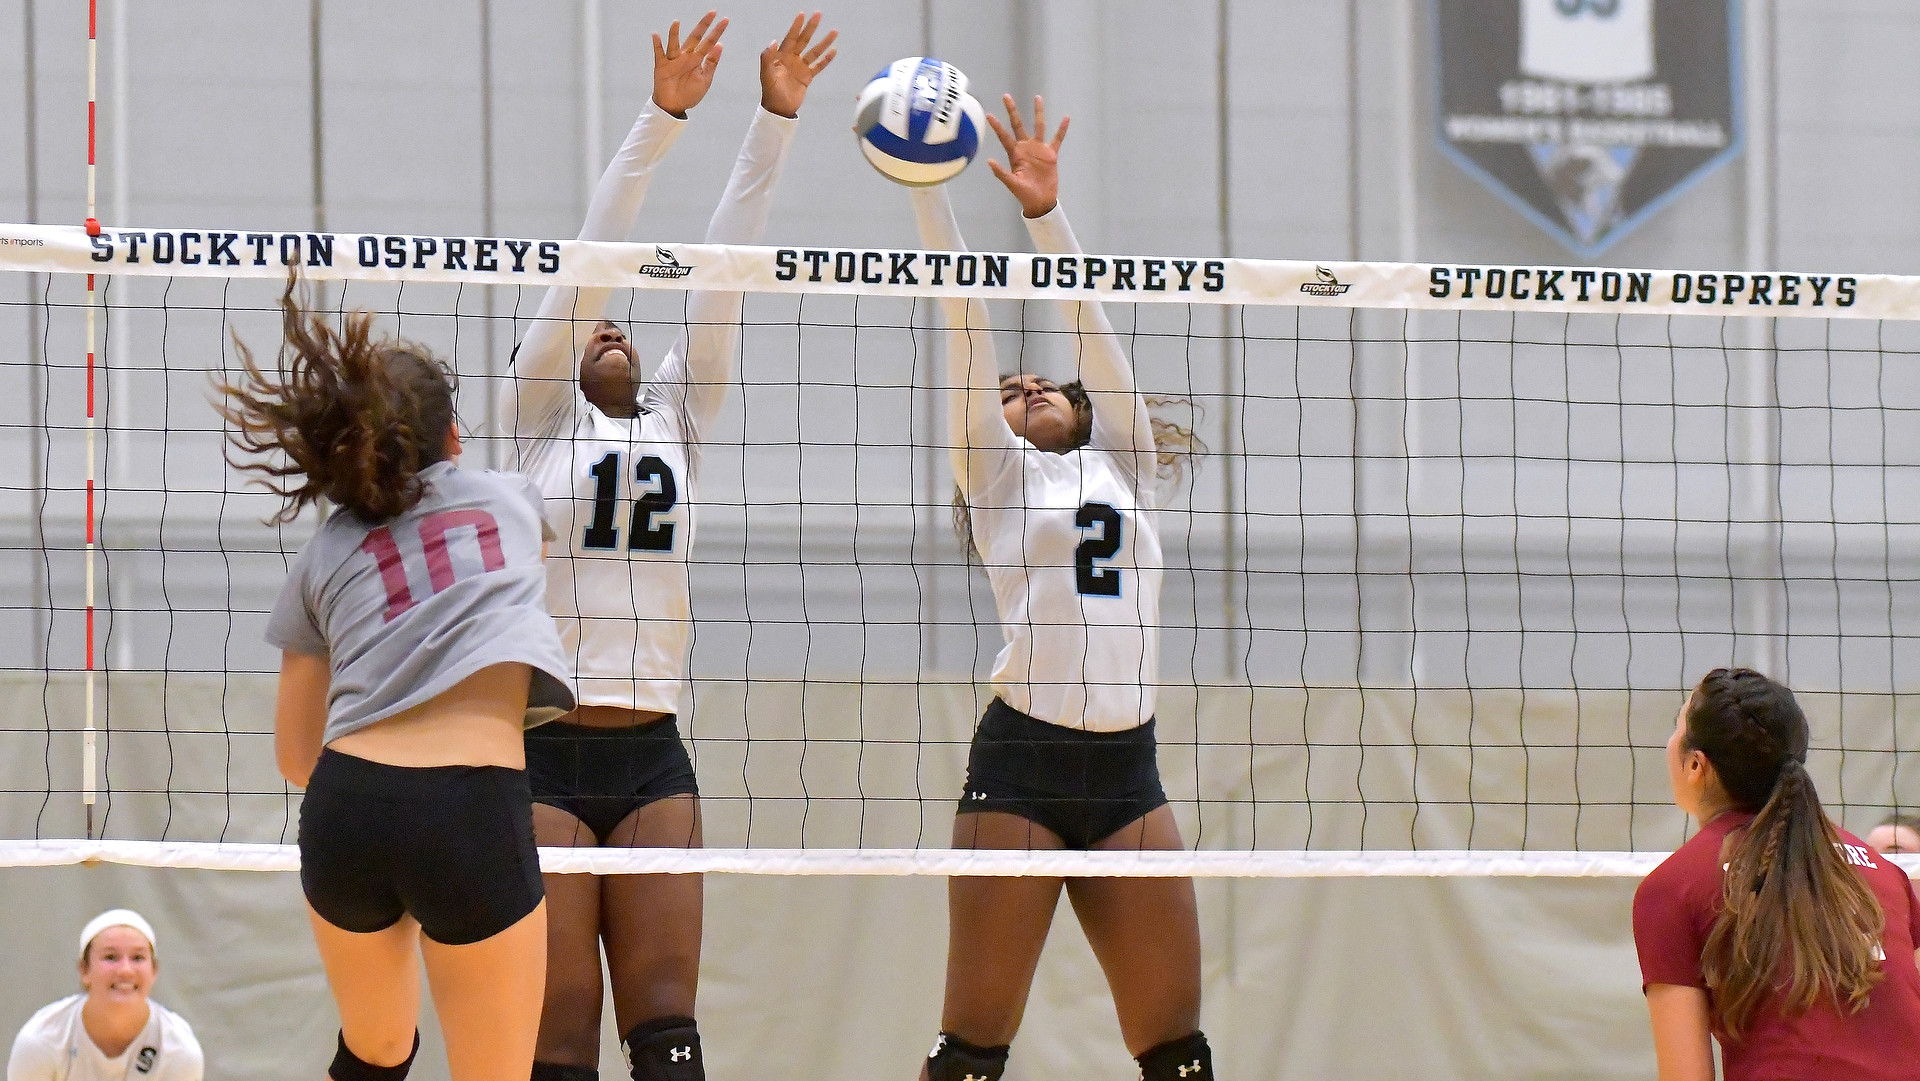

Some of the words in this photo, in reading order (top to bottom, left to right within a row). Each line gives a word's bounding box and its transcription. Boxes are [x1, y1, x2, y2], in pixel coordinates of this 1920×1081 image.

[91, 232, 335, 267] STOCKTON
[357, 236, 561, 274] OSPREYS
[641, 265, 689, 275] STOCKTON
[775, 249, 1010, 287] STOCKTON
[1031, 256, 1225, 292] OSPREYS
[1302, 284, 1347, 292] STOCKTON
[1429, 267, 1652, 303] STOCKTON
[1671, 273, 1857, 307] OSPREYS
[582, 450, 679, 554] 12
[1073, 500, 1123, 599] 2
